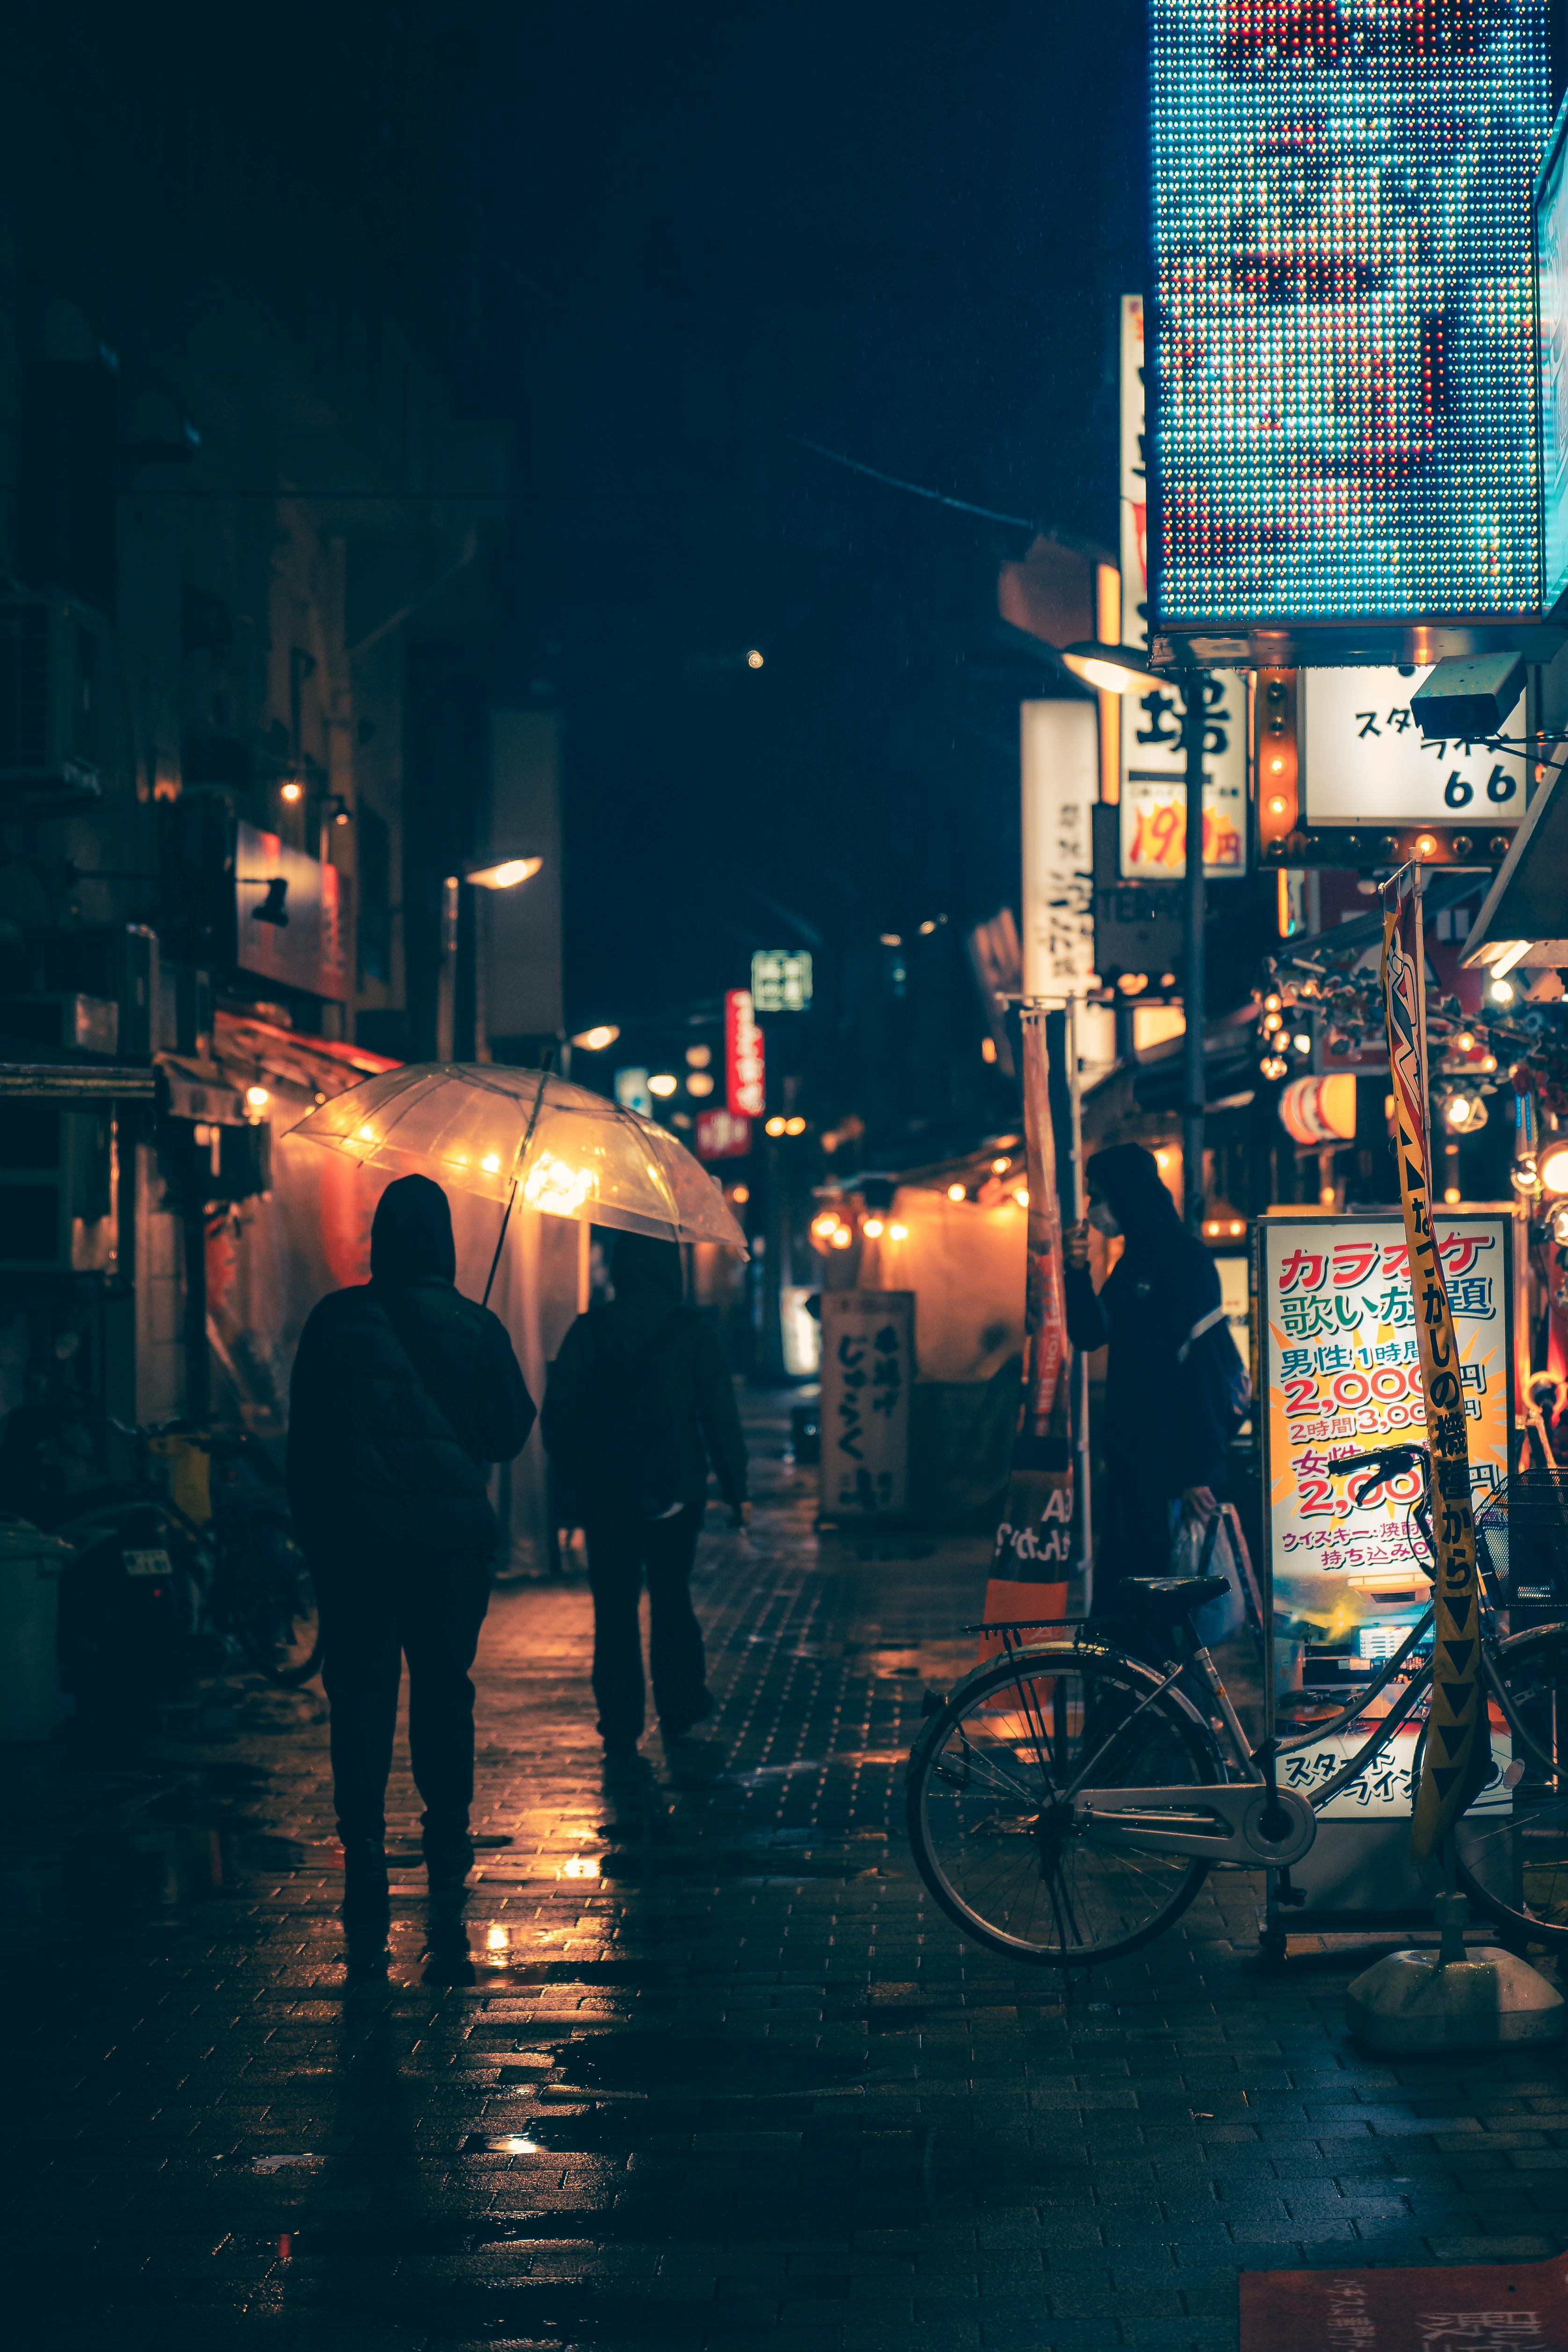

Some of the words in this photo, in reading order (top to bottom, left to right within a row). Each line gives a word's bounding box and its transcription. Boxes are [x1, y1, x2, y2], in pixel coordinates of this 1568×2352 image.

[1444, 763, 1517, 809] 66
[1280, 1277, 1492, 1336] 歌い放題
[1281, 1521, 1432, 1548] ウイスキー・焼酎
